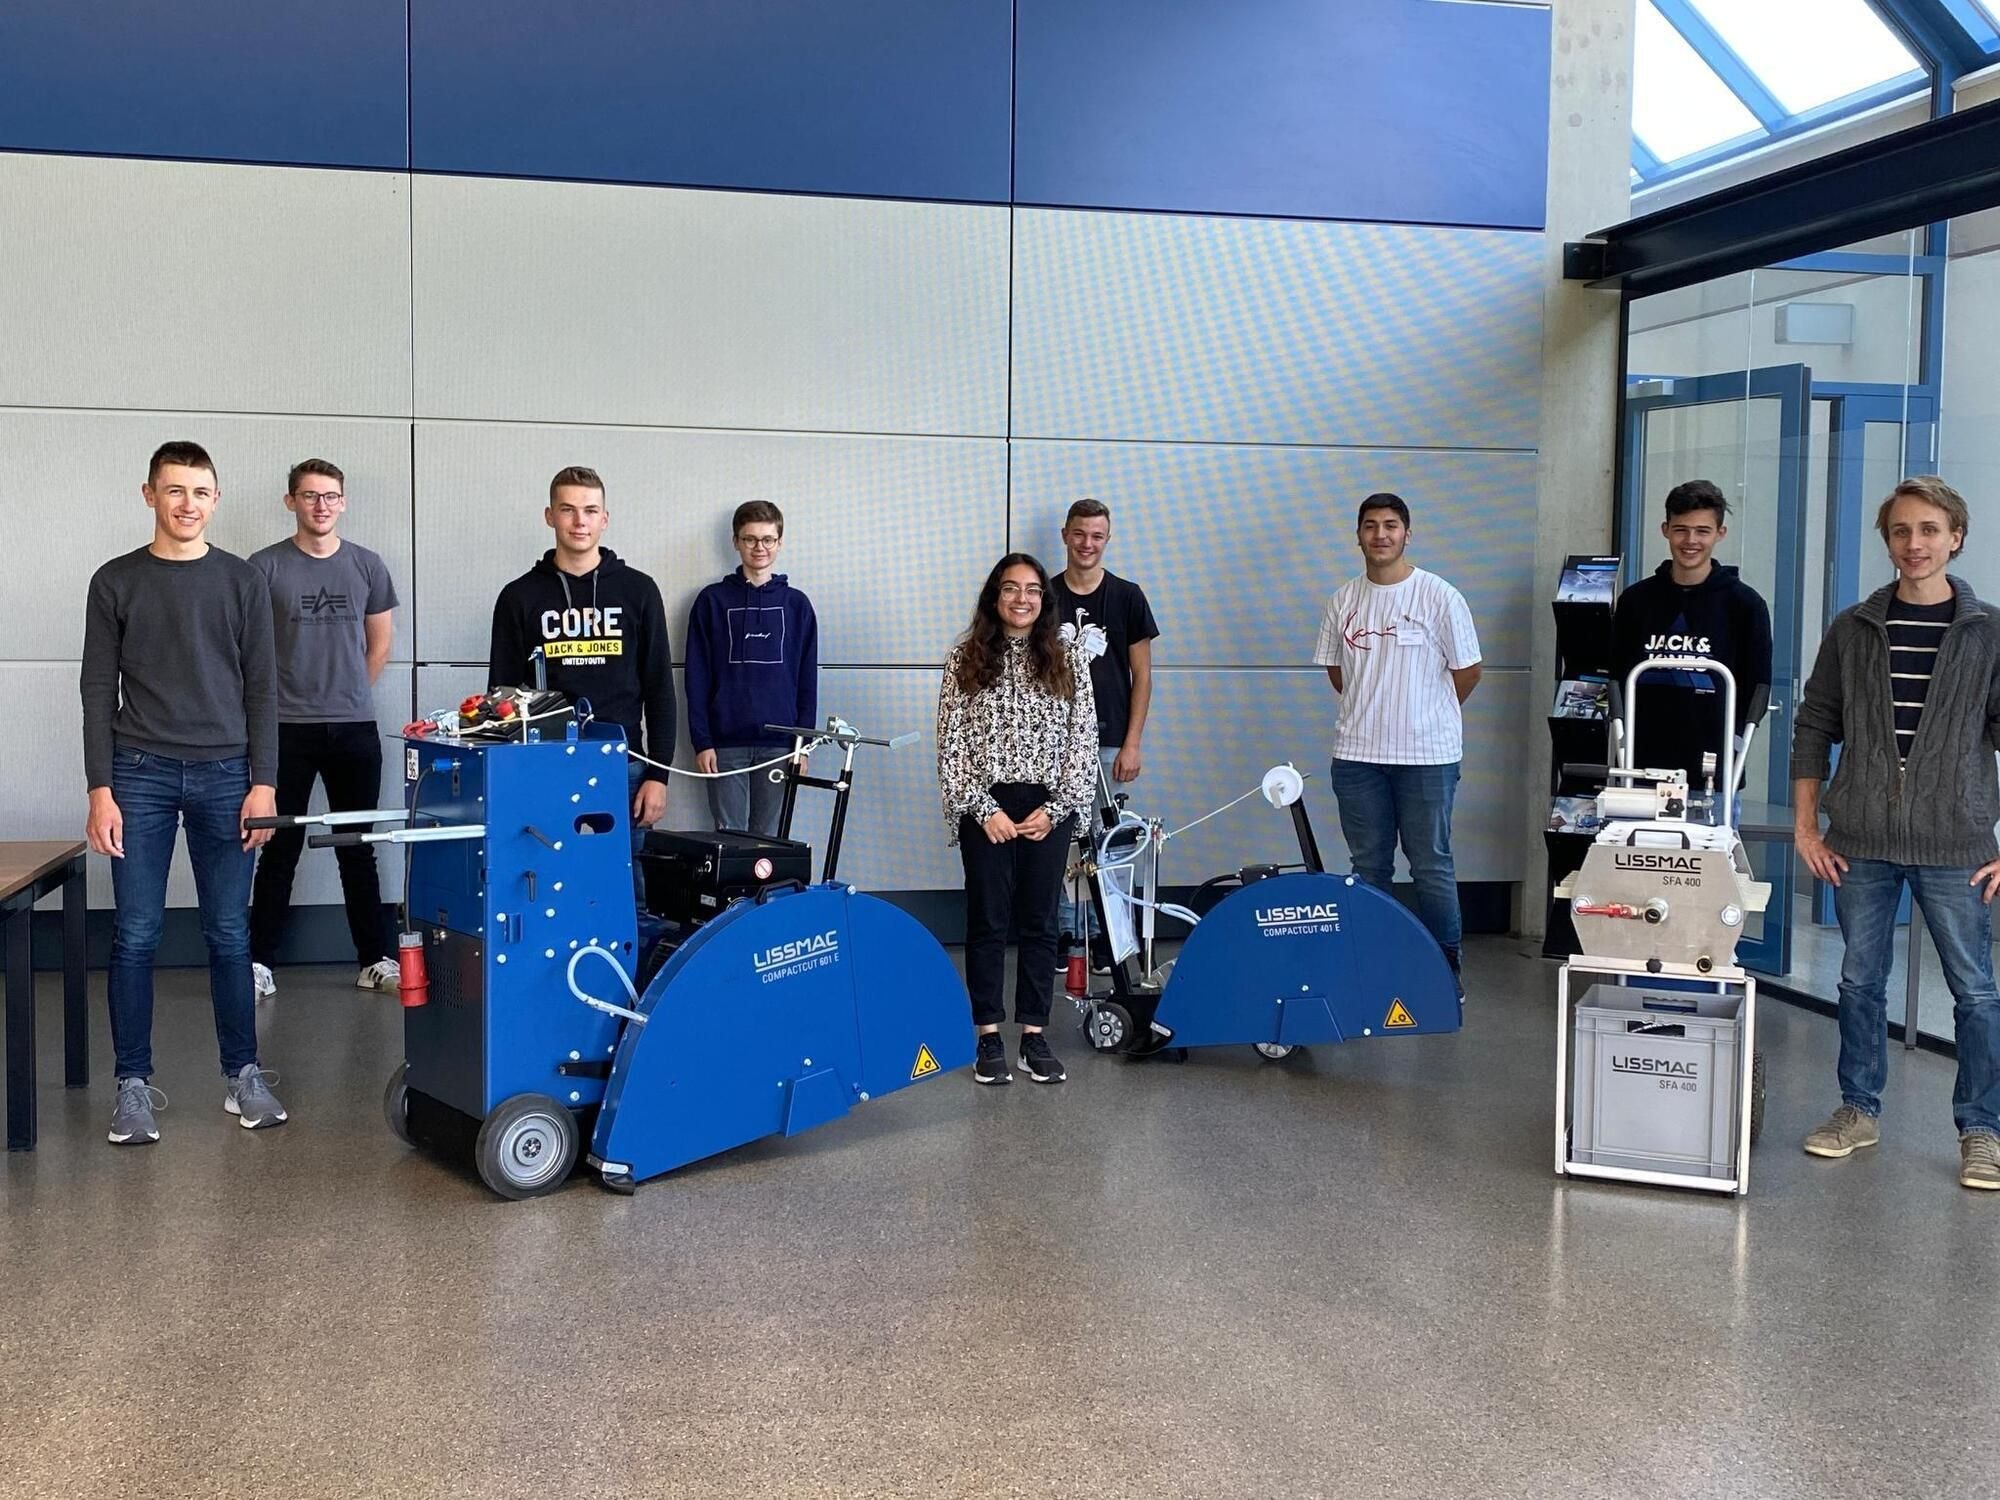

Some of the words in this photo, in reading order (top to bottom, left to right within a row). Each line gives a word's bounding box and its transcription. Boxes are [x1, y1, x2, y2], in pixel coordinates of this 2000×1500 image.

[541, 607, 623, 640] CORE
[547, 644, 574, 655] JACK
[577, 644, 583, 653] &
[587, 642, 620, 653] JONES
[1644, 634, 1698, 651] JACK
[1696, 637, 1711, 653] &
[1615, 853, 1702, 870] LISSMAC
[1662, 875, 1682, 887] SFA
[1684, 877, 1701, 888] 400
[1255, 903, 1339, 922] LISSMAC
[1263, 924, 1319, 937] COMPACTCUT
[1320, 923, 1333, 933] 401
[1335, 923, 1341, 932] E
[753, 930, 838, 967] LISSMAC
[762, 959, 819, 984] COMPACTCUT
[819, 954, 833, 967] 601
[834, 952, 840, 962] E
[1612, 1055, 1698, 1075] LISSMAC
[1659, 1079, 1678, 1090] SFA
[1680, 1082, 1697, 1092] 400
